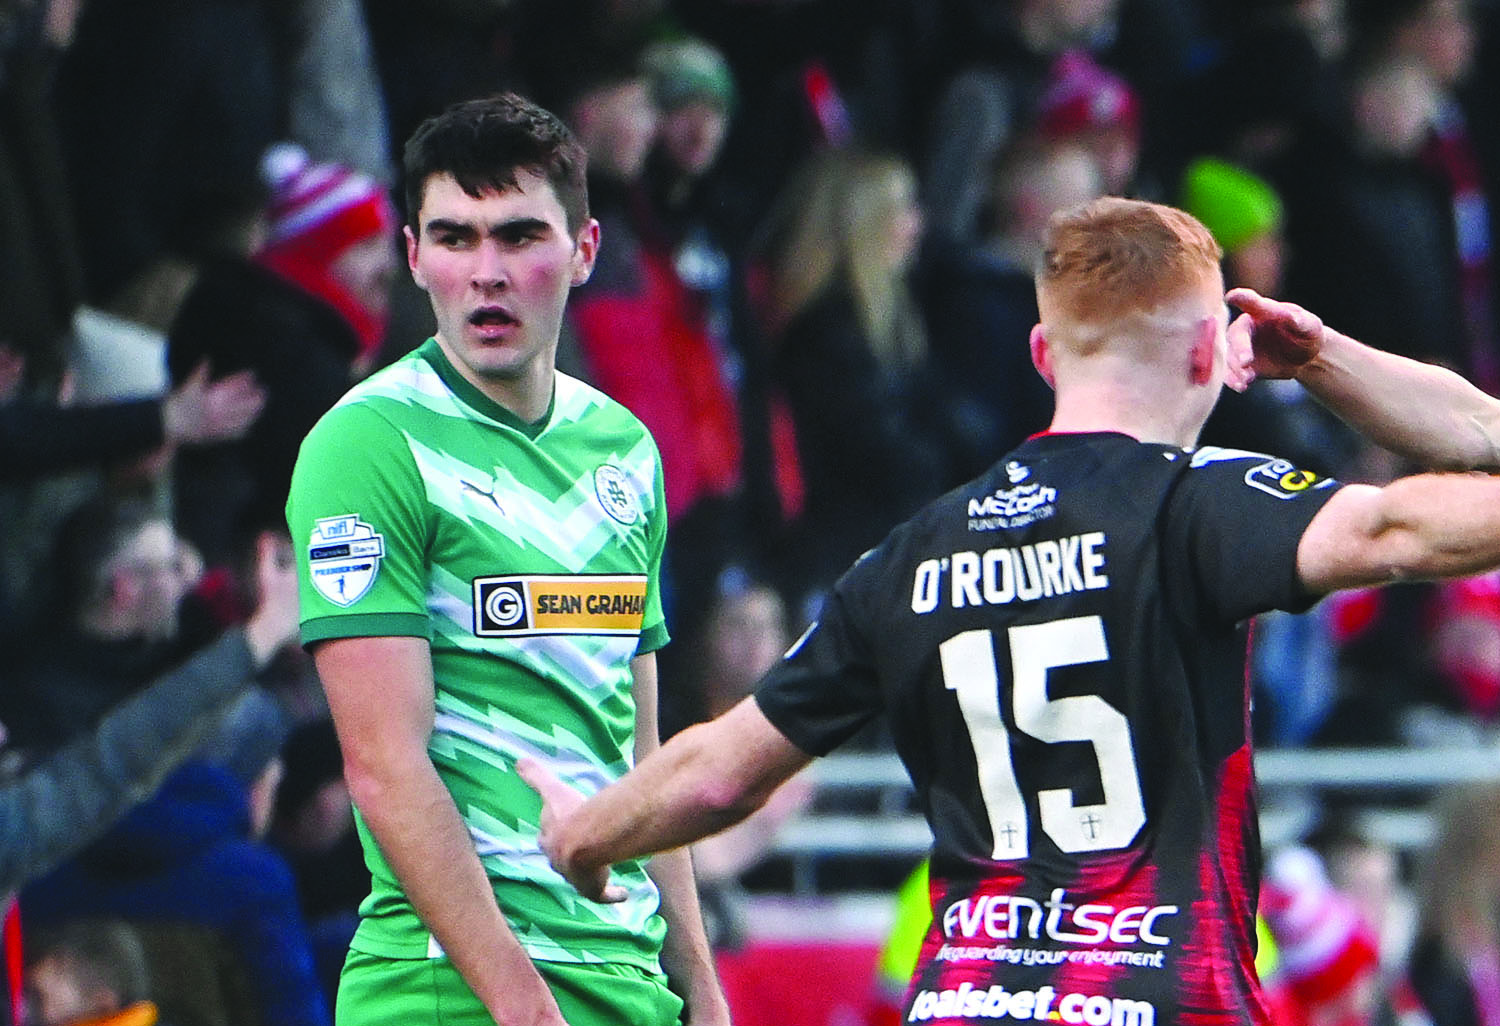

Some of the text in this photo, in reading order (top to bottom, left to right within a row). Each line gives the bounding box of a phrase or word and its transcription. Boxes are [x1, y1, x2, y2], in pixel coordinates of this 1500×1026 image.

[911, 532, 1109, 614] O'ROURKE
[537, 594, 581, 614] SEAN
[939, 615, 1147, 860] 15
[1023, 949, 1069, 966] your
[1067, 948, 1166, 969] enjoyment
